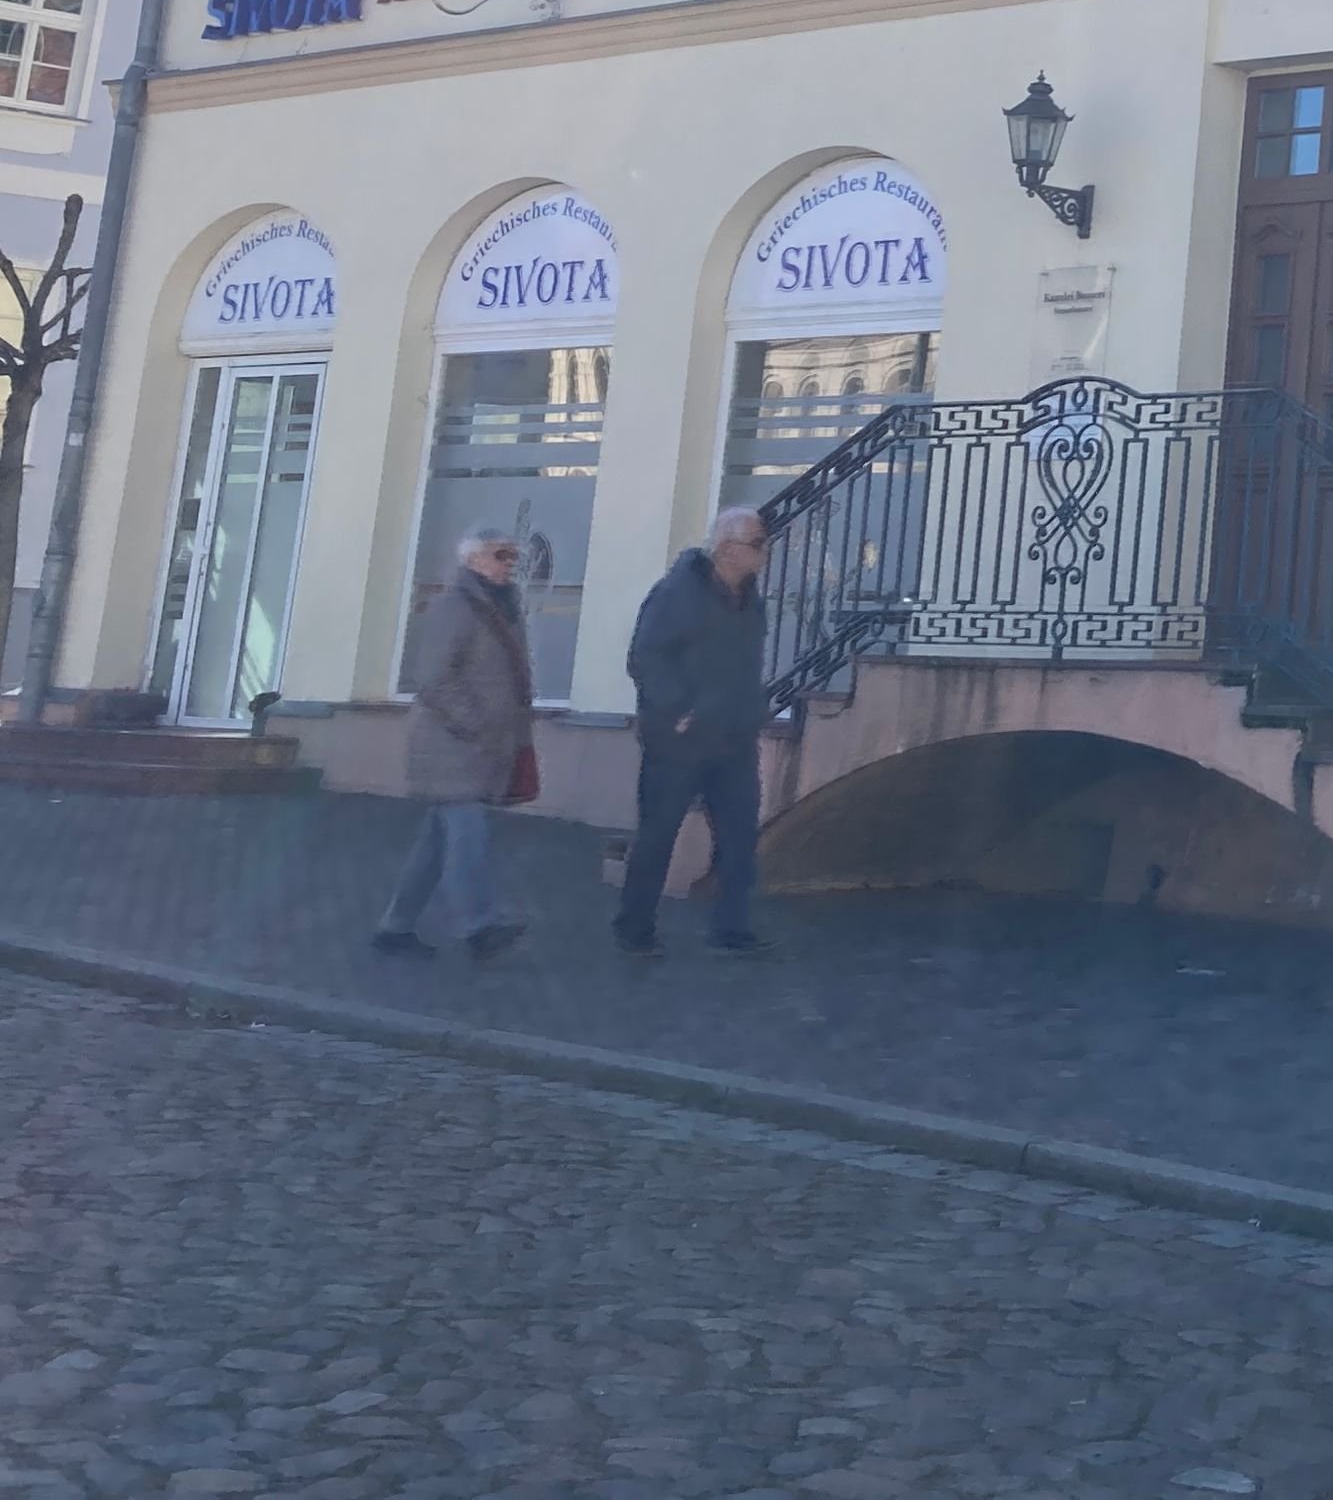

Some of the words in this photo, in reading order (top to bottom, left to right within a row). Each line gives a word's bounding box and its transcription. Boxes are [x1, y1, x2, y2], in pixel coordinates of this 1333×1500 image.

[461, 200, 558, 282] Griechisches
[756, 174, 869, 263] Griechisches
[205, 222, 294, 298] Griechisches
[477, 255, 612, 310] SIVOTA
[776, 234, 933, 292] SIVOTA
[218, 275, 335, 324] SIVOTA
